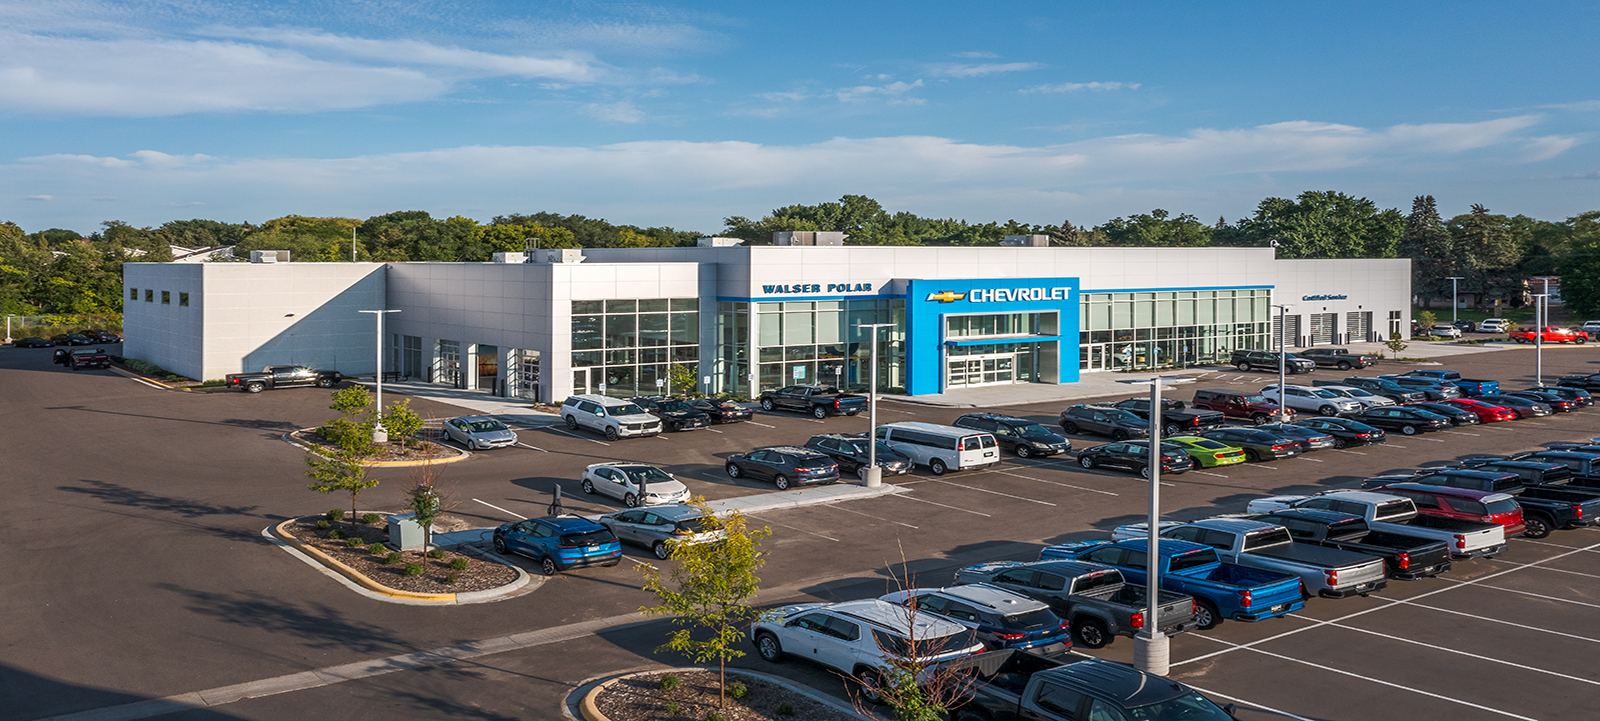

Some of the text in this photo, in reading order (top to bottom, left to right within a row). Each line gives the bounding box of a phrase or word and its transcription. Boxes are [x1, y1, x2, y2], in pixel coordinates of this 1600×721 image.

[762, 283, 872, 294] WALSER POLAR
[969, 287, 1072, 303] CHEVROLET
